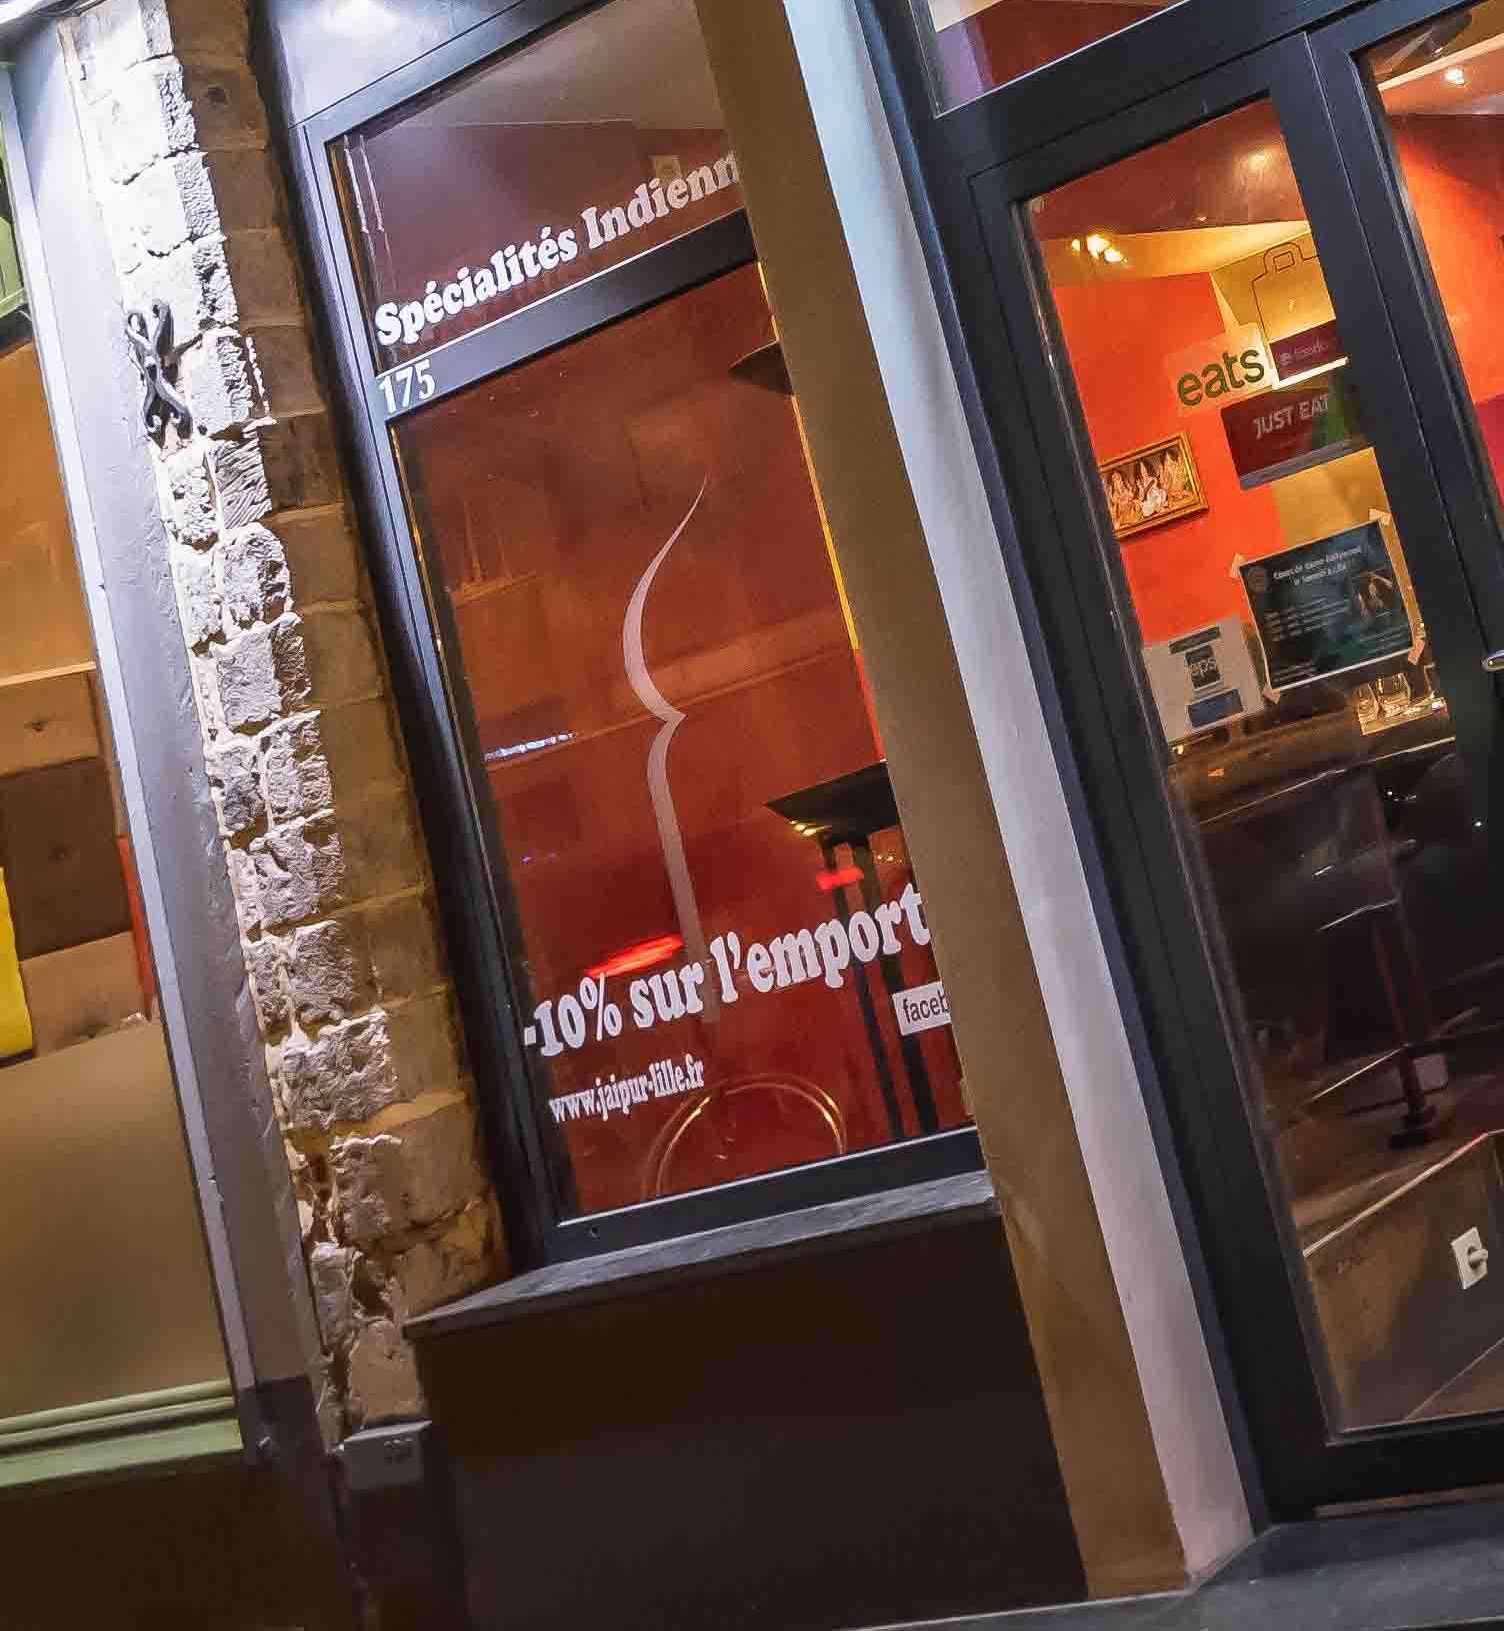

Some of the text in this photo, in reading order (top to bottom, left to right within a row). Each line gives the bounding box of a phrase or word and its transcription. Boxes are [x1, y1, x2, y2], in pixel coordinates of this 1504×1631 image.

[375, 225, 579, 347] Spécialités
[378, 358, 436, 413] 175
[1177, 349, 1265, 406] eats
[1253, 393, 1329, 440] JUST EAT
[524, 971, 624, 1059] -10%
[630, 961, 705, 1029] sur
[548, 1052, 705, 1124] www.jaipur-lille.fr
